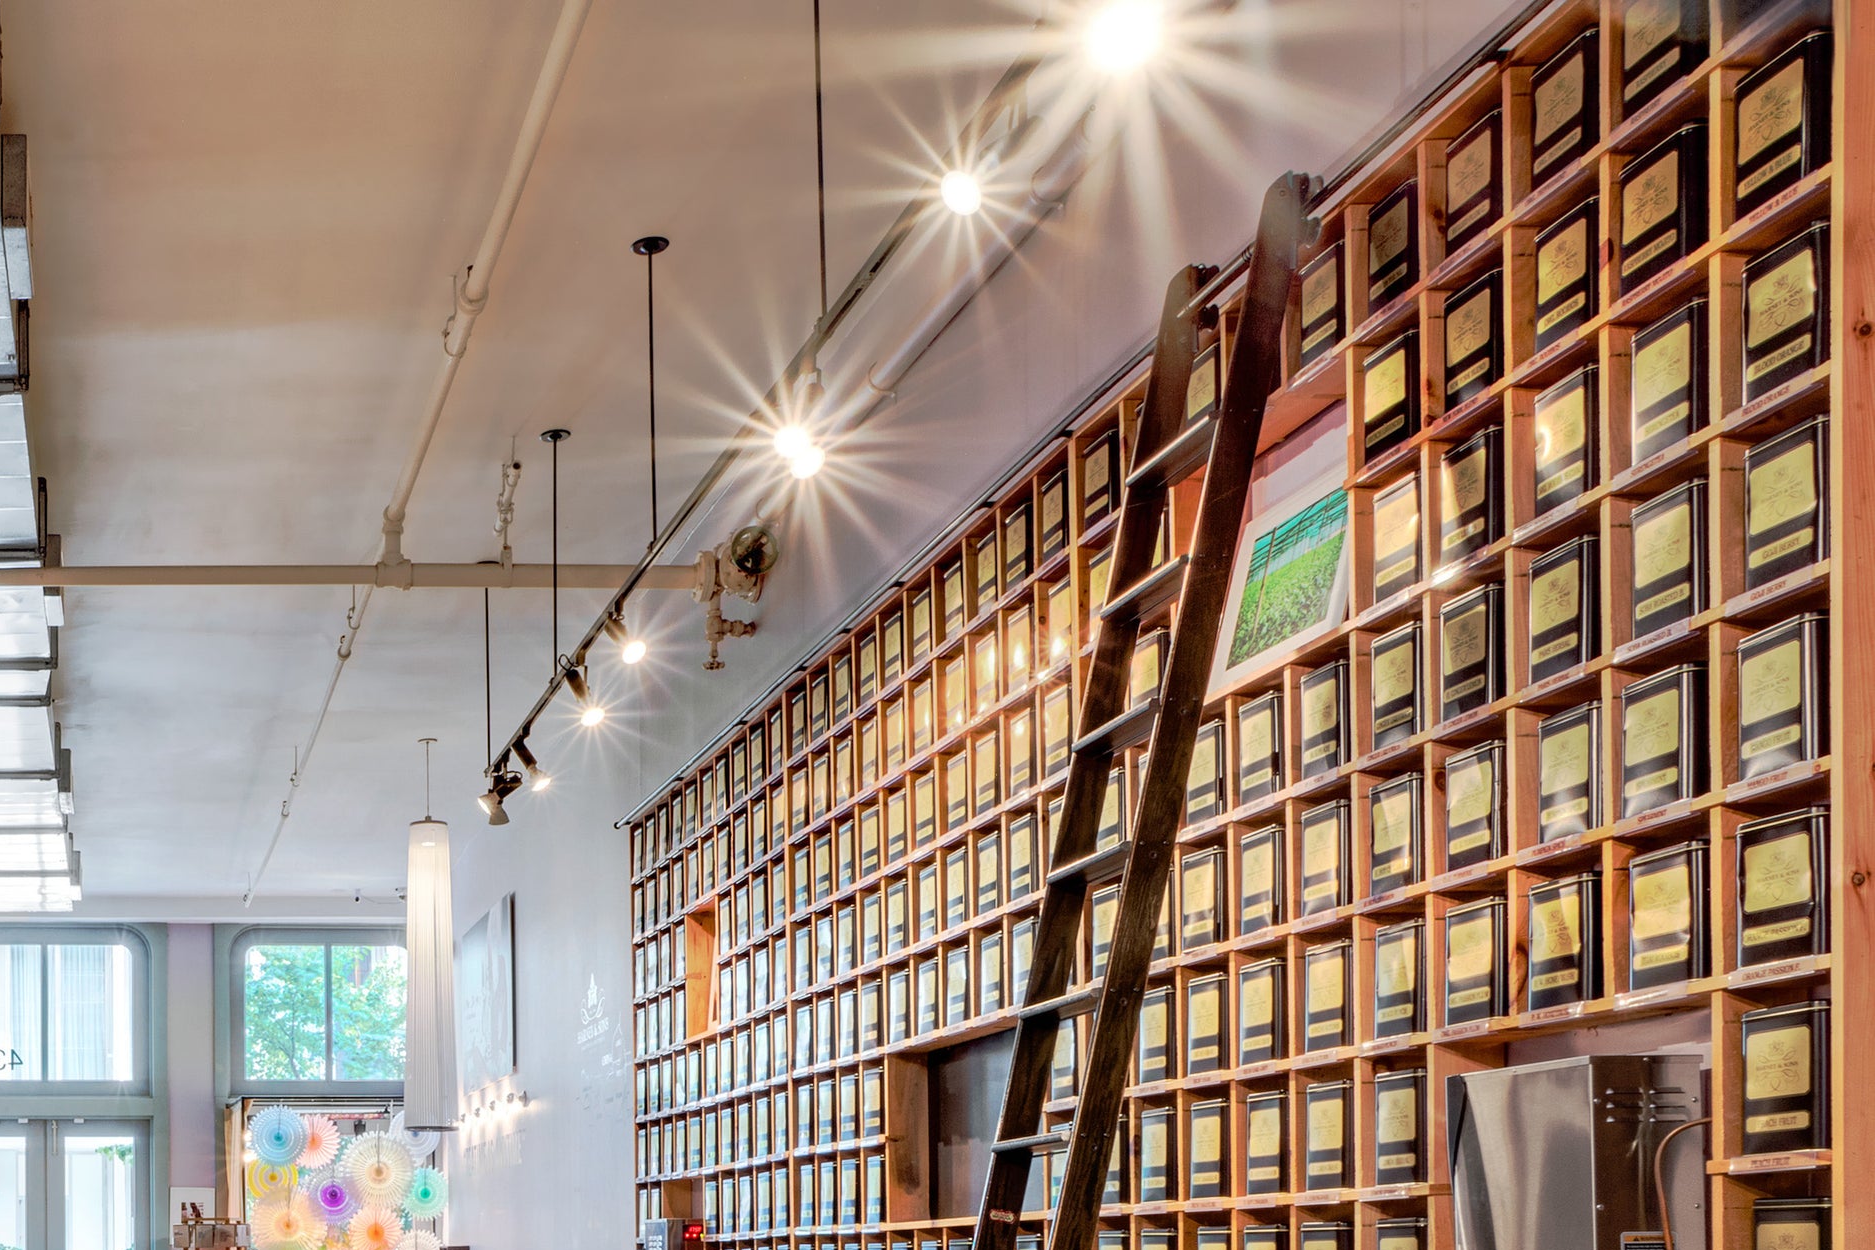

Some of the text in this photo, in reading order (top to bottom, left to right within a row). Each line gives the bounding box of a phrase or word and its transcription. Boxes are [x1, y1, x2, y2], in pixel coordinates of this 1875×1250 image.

[1743, 170, 1770, 189] YELLOW
[1775, 152, 1793, 170] BLUE
[1780, 186, 1799, 202] BLUE
[1753, 340, 1806, 375] BLOOD ORANGE
[1741, 385, 1791, 418] BLOOD ORANGE
[1762, 537, 1801, 560] GOJI BERRY
[1750, 580, 1788, 602] GOJI BERRY
[1777, 1115, 1798, 1127] FRUIT
